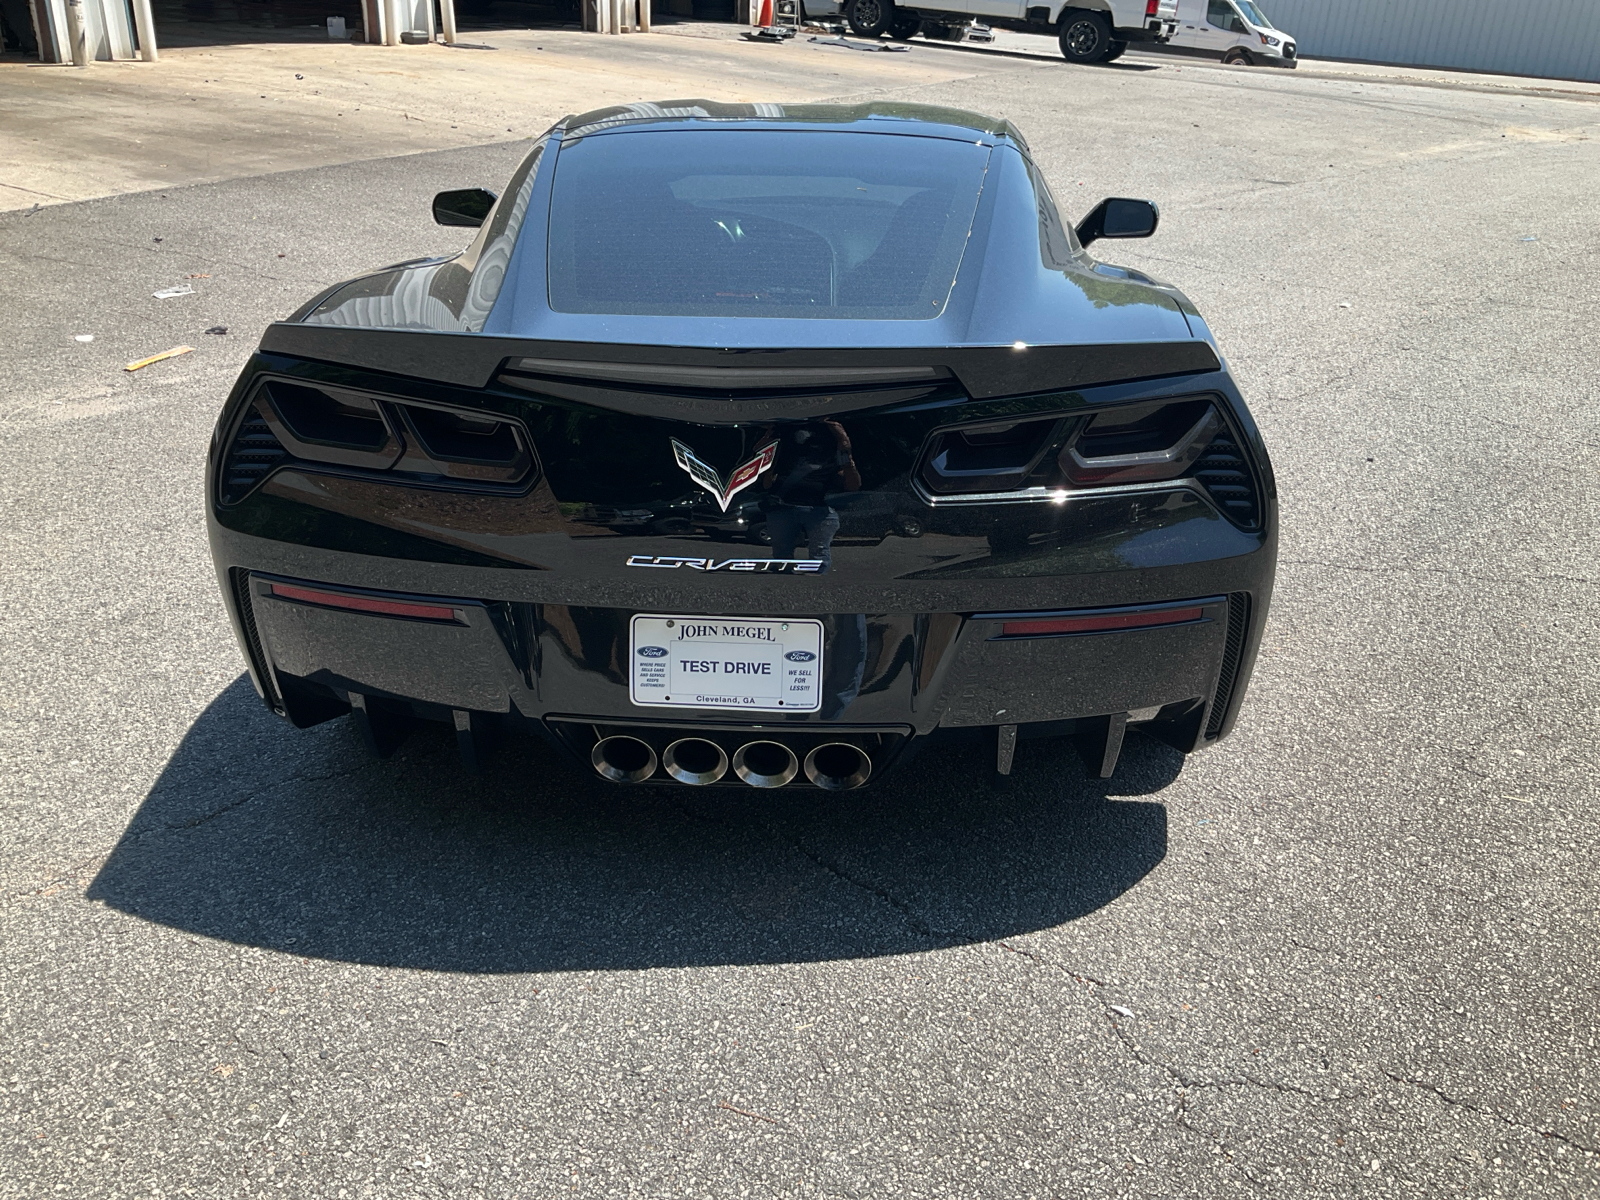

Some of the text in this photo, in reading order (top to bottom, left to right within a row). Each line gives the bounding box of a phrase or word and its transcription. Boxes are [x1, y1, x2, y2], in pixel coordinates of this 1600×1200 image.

[626, 555, 824, 571] CORVETTE
[678, 624, 776, 642] JOHN MEGEL
[680, 660, 771, 675] TEST DRIVE
[696, 695, 740, 705] Cleveland,
